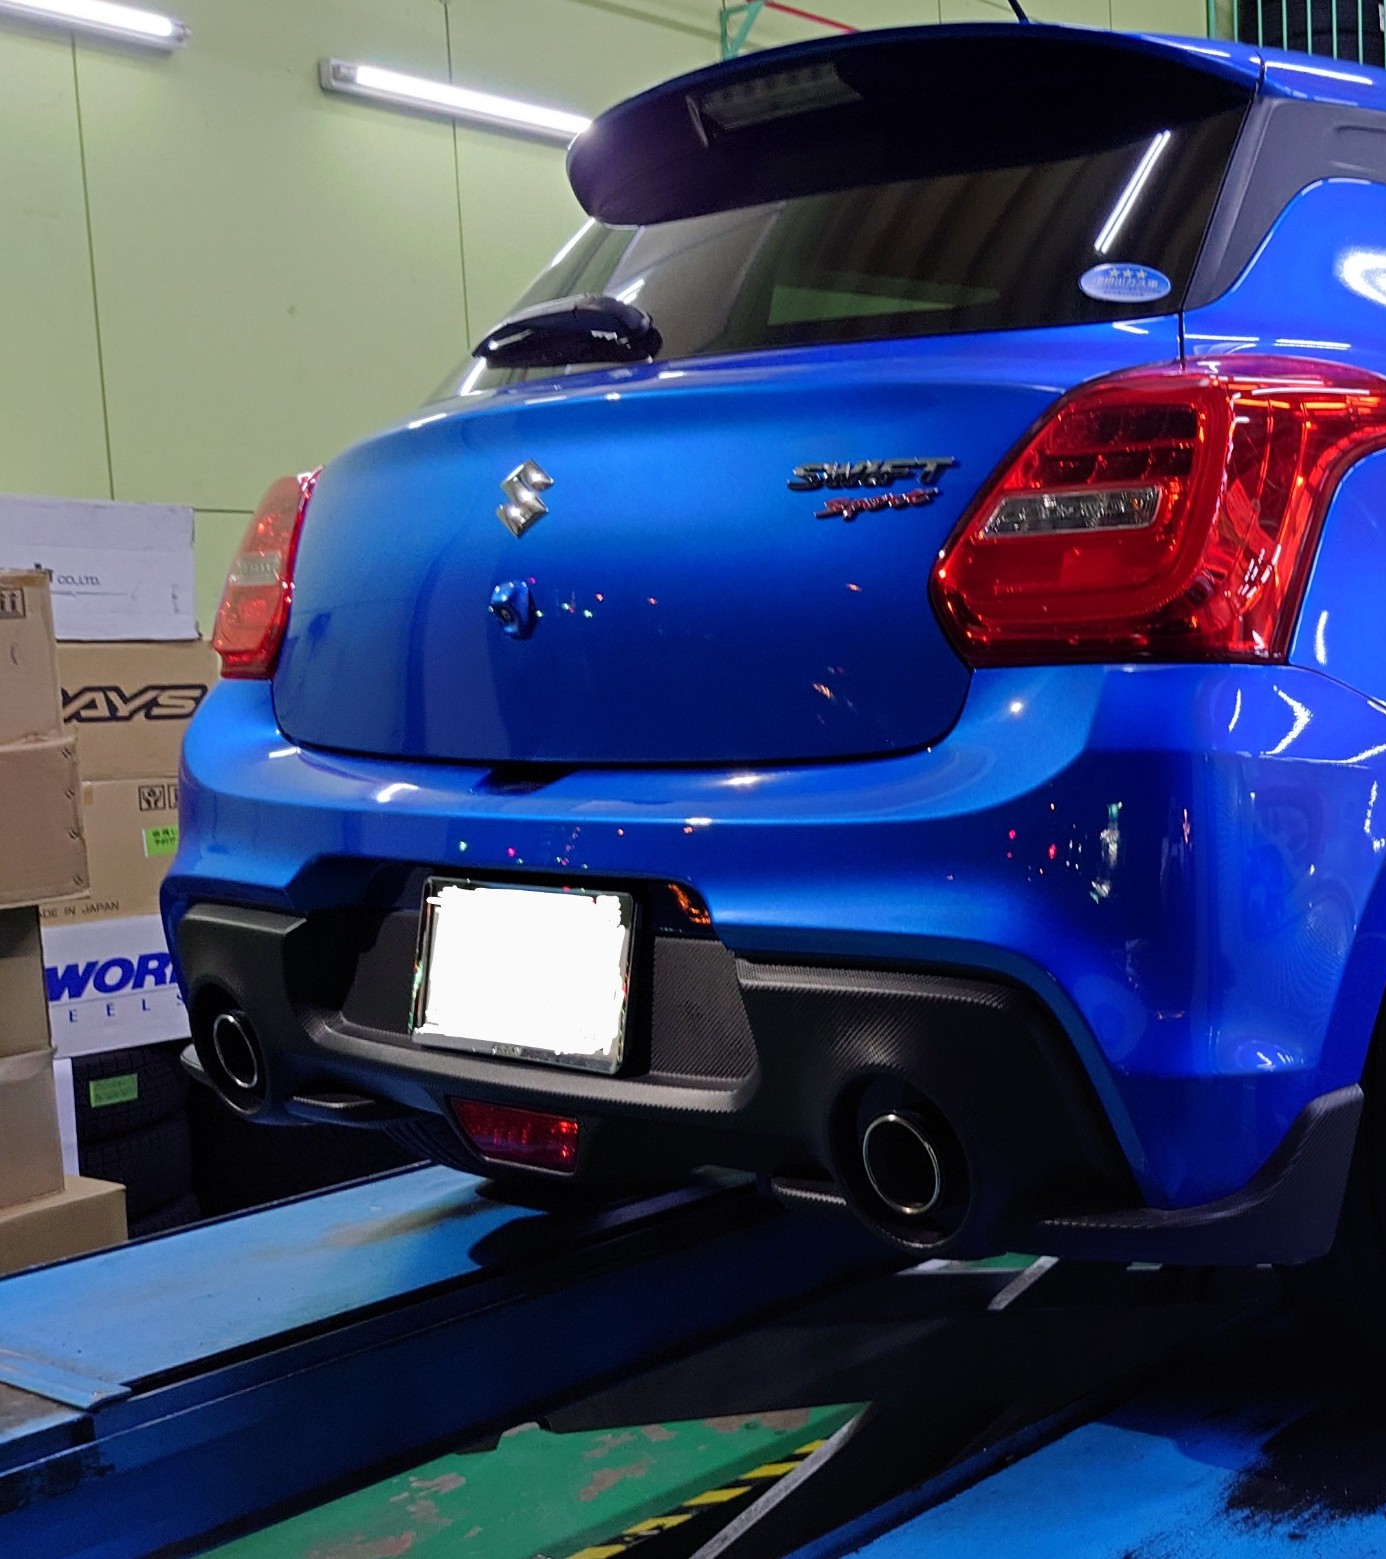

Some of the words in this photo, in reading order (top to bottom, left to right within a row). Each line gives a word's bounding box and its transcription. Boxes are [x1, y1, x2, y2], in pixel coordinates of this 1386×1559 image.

[787, 456, 954, 488] SWIFT
[64, 906, 76, 916] IN
[82, 900, 119, 914] JAPAN
